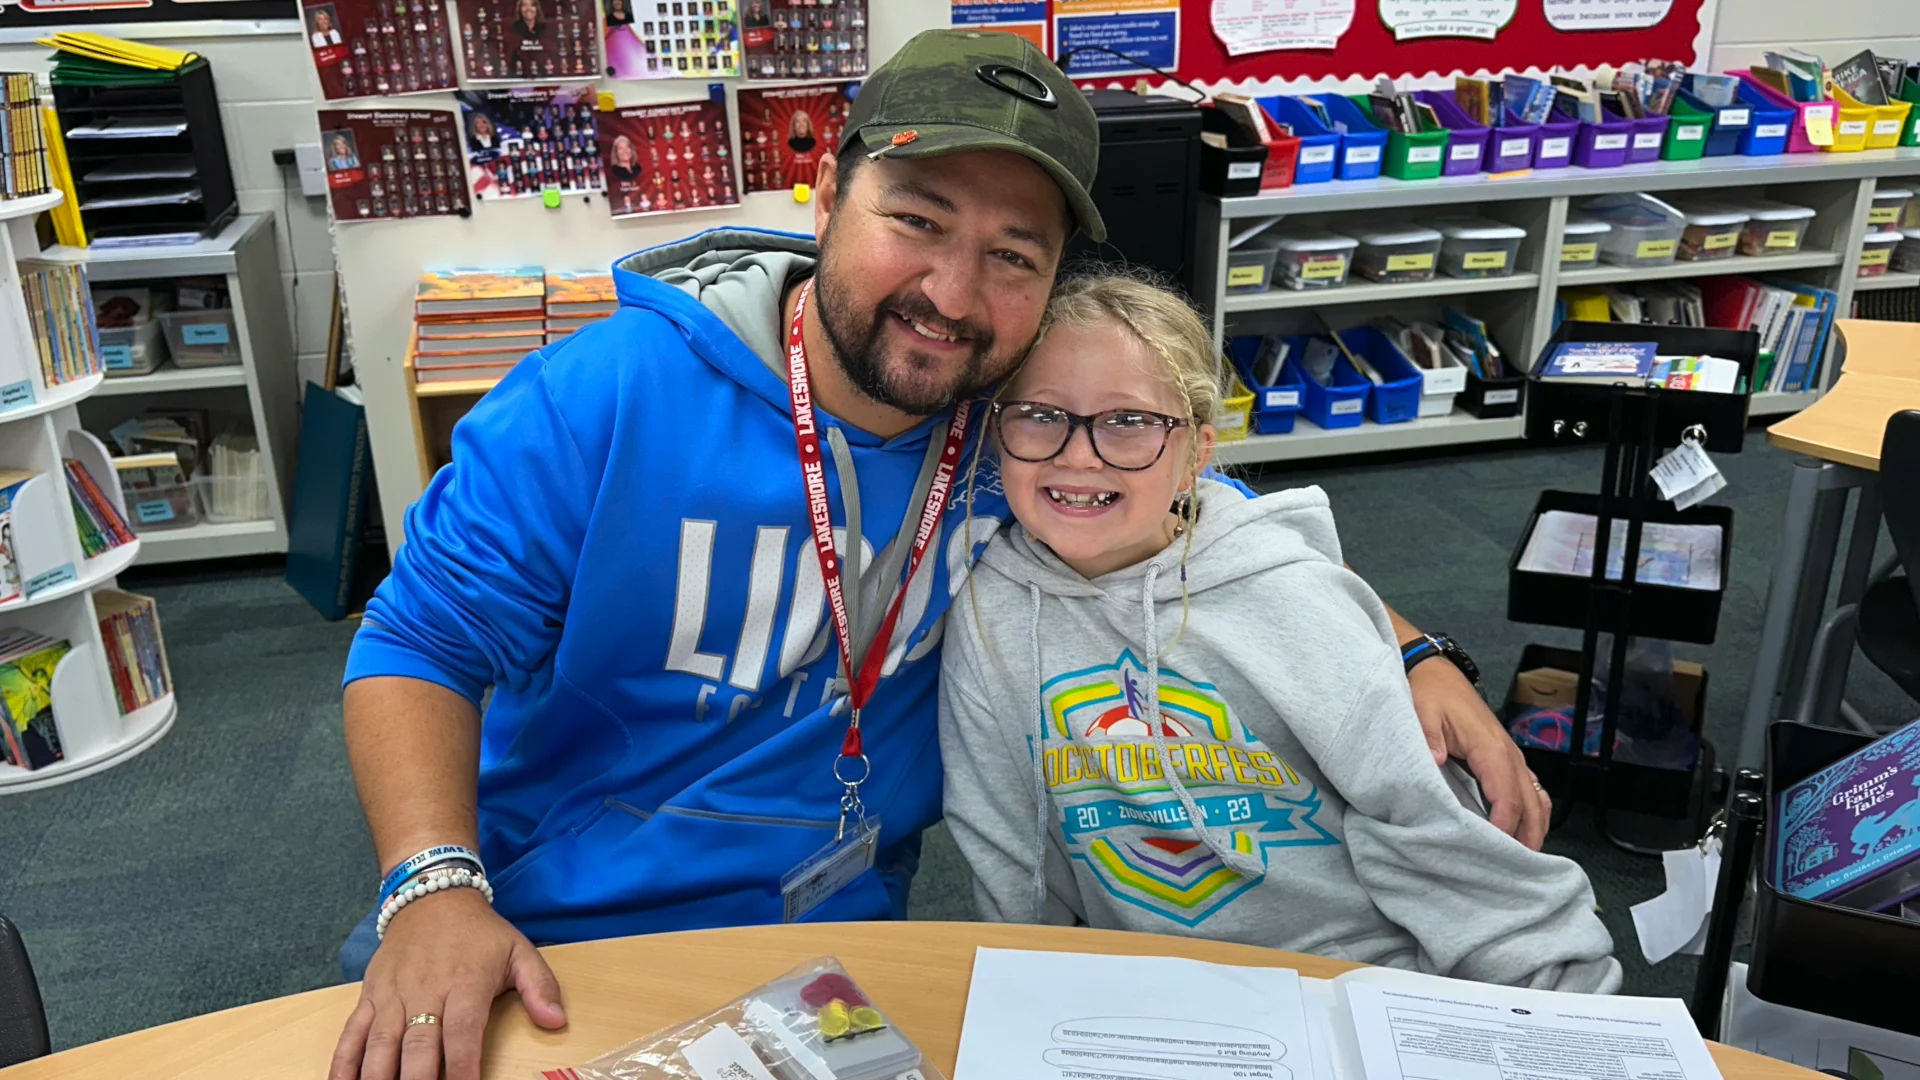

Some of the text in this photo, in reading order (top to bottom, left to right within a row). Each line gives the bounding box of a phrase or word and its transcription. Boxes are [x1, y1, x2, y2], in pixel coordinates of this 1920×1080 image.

[790, 341, 815, 435] LAKESHORE
[805, 461, 834, 553] LAKESHORE
[914, 462, 954, 551] LAKESHORE
[826, 575, 851, 664] LAKESHORE
[1832, 766, 1898, 806] Grimm's
[1845, 781, 1887, 810] Fairy
[1852, 789, 1895, 817] Tales
[1077, 807, 1100, 828] 20
[1118, 805, 1188, 824] ZIONSVILLE
[1227, 797, 1251, 822] 23
[1825, 843, 1912, 888] The Brothers Grimm
[1239, 1050, 1271, 1058] Anything
[1250, 1071, 1273, 1079] Target
